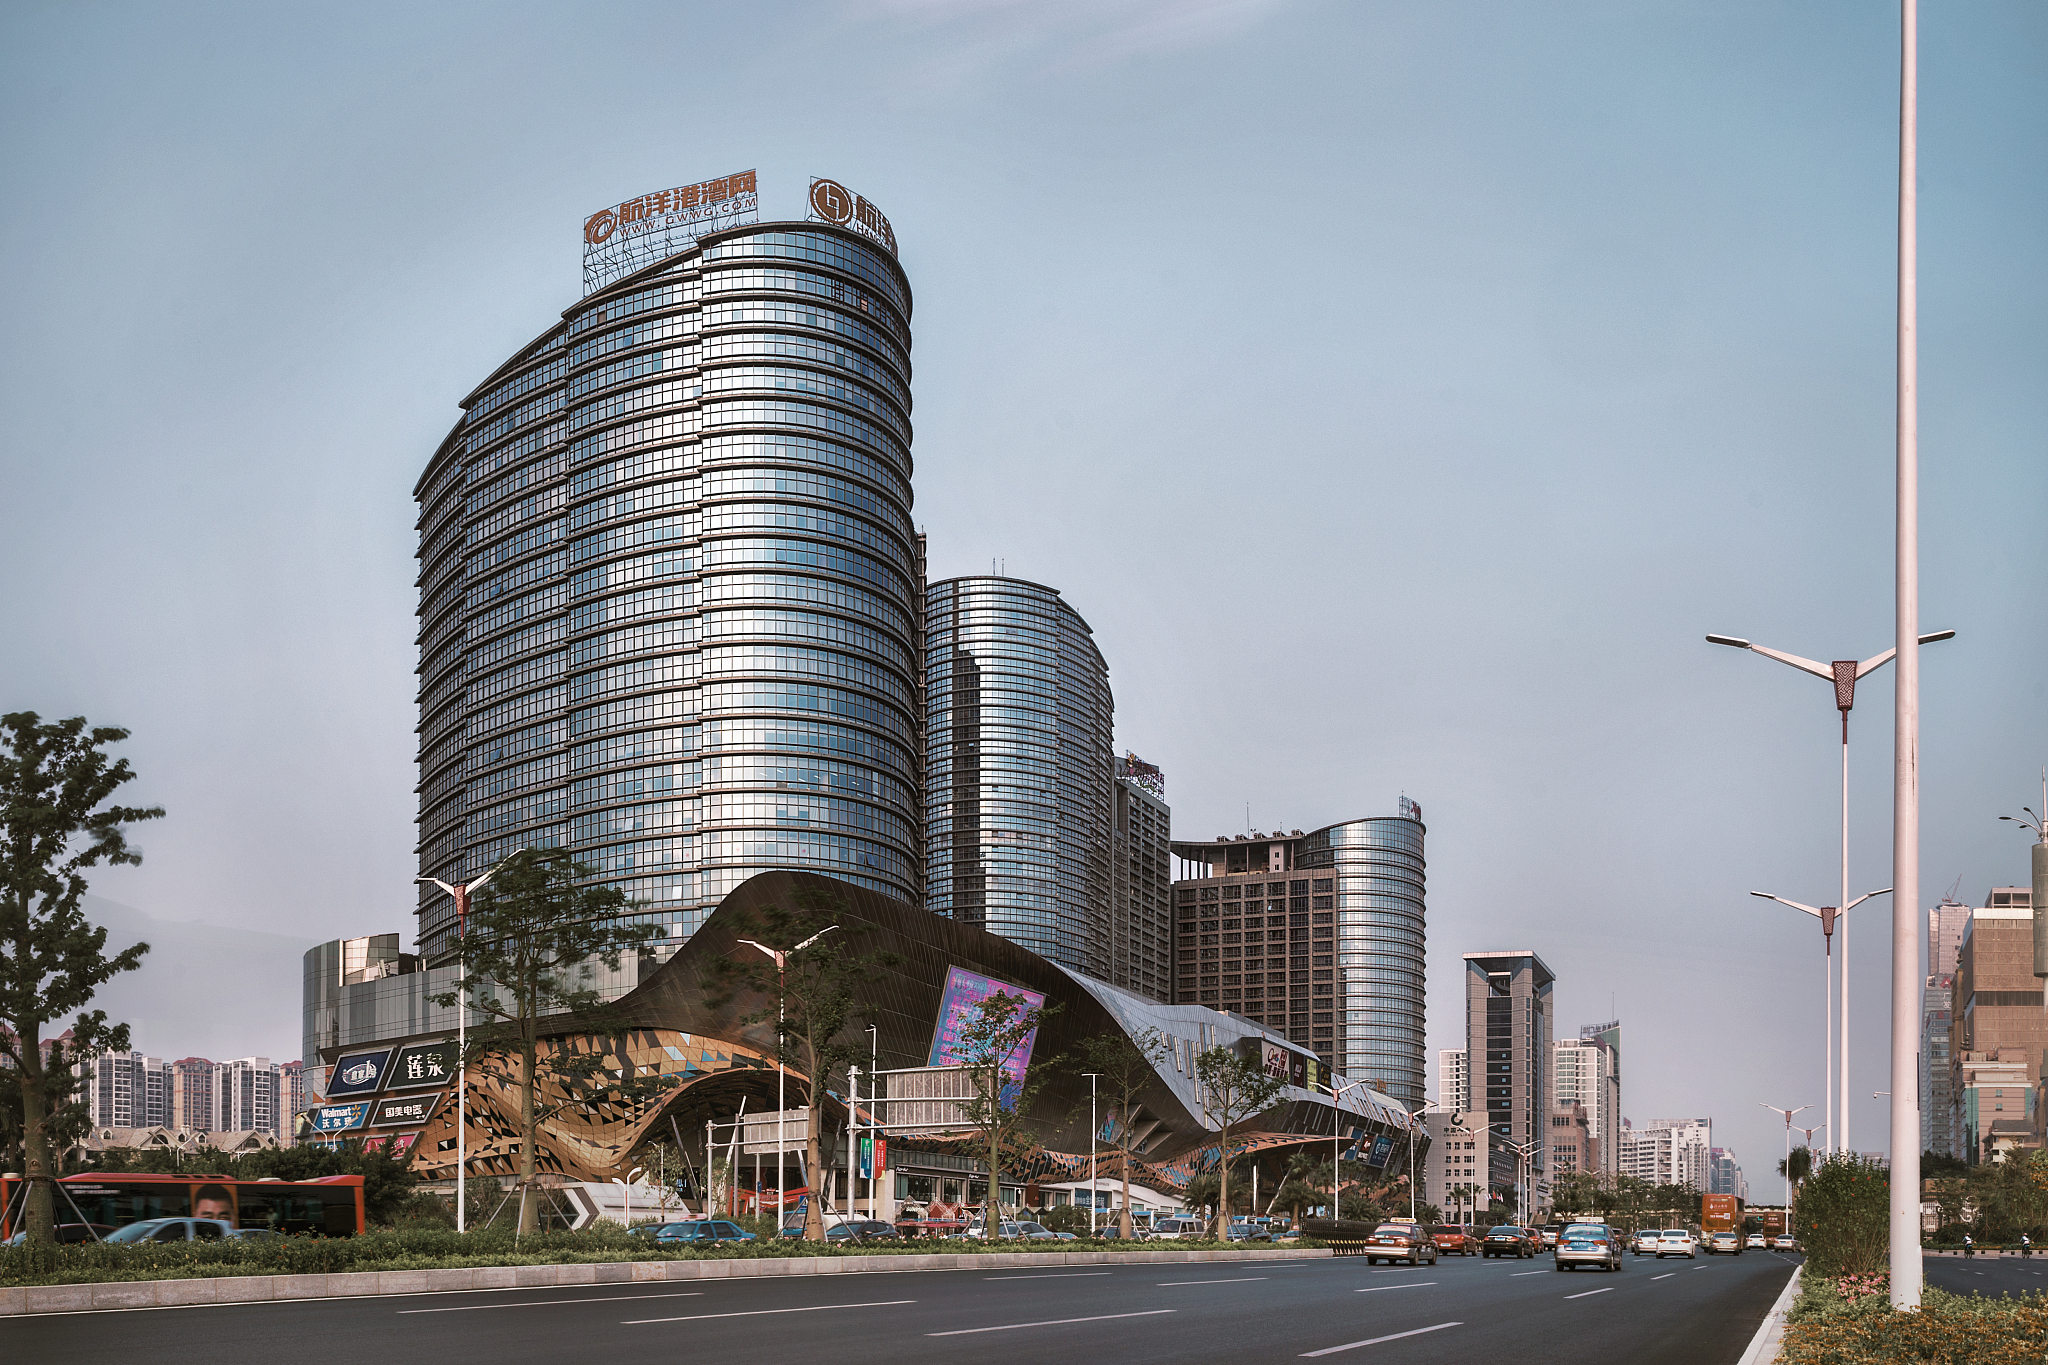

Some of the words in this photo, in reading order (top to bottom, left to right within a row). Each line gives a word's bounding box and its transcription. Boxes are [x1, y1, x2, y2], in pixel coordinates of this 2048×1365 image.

[619, 171, 756, 226] 航洋港湾网
[321, 1106, 352, 1119] Walmart
[385, 1104, 423, 1118] 国美电器
